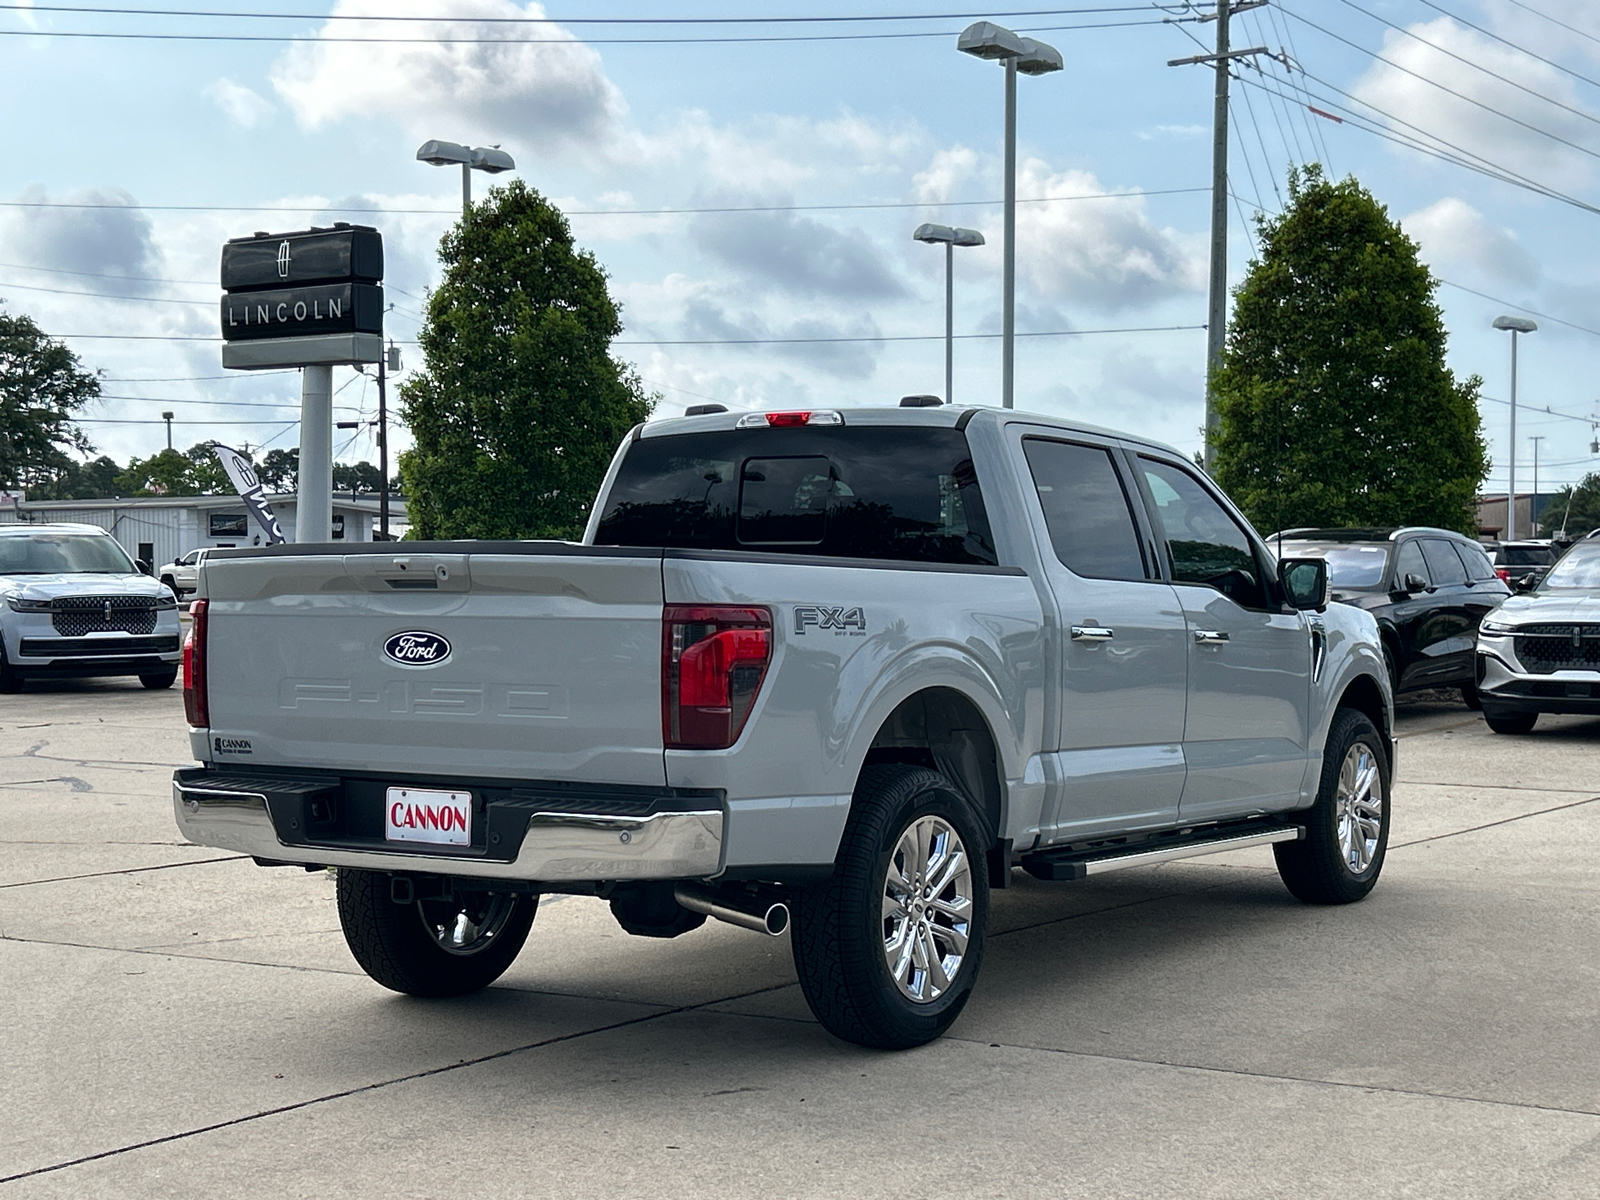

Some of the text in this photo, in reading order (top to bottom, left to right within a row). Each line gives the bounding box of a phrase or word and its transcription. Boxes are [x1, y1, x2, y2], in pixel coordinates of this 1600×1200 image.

[229, 298, 342, 326] LINCOLN
[793, 605, 866, 635] FX4
[395, 635, 438, 659] Ford
[278, 676, 569, 720] F-150
[222, 738, 252, 749] CANNON
[390, 801, 467, 833] CANNON
